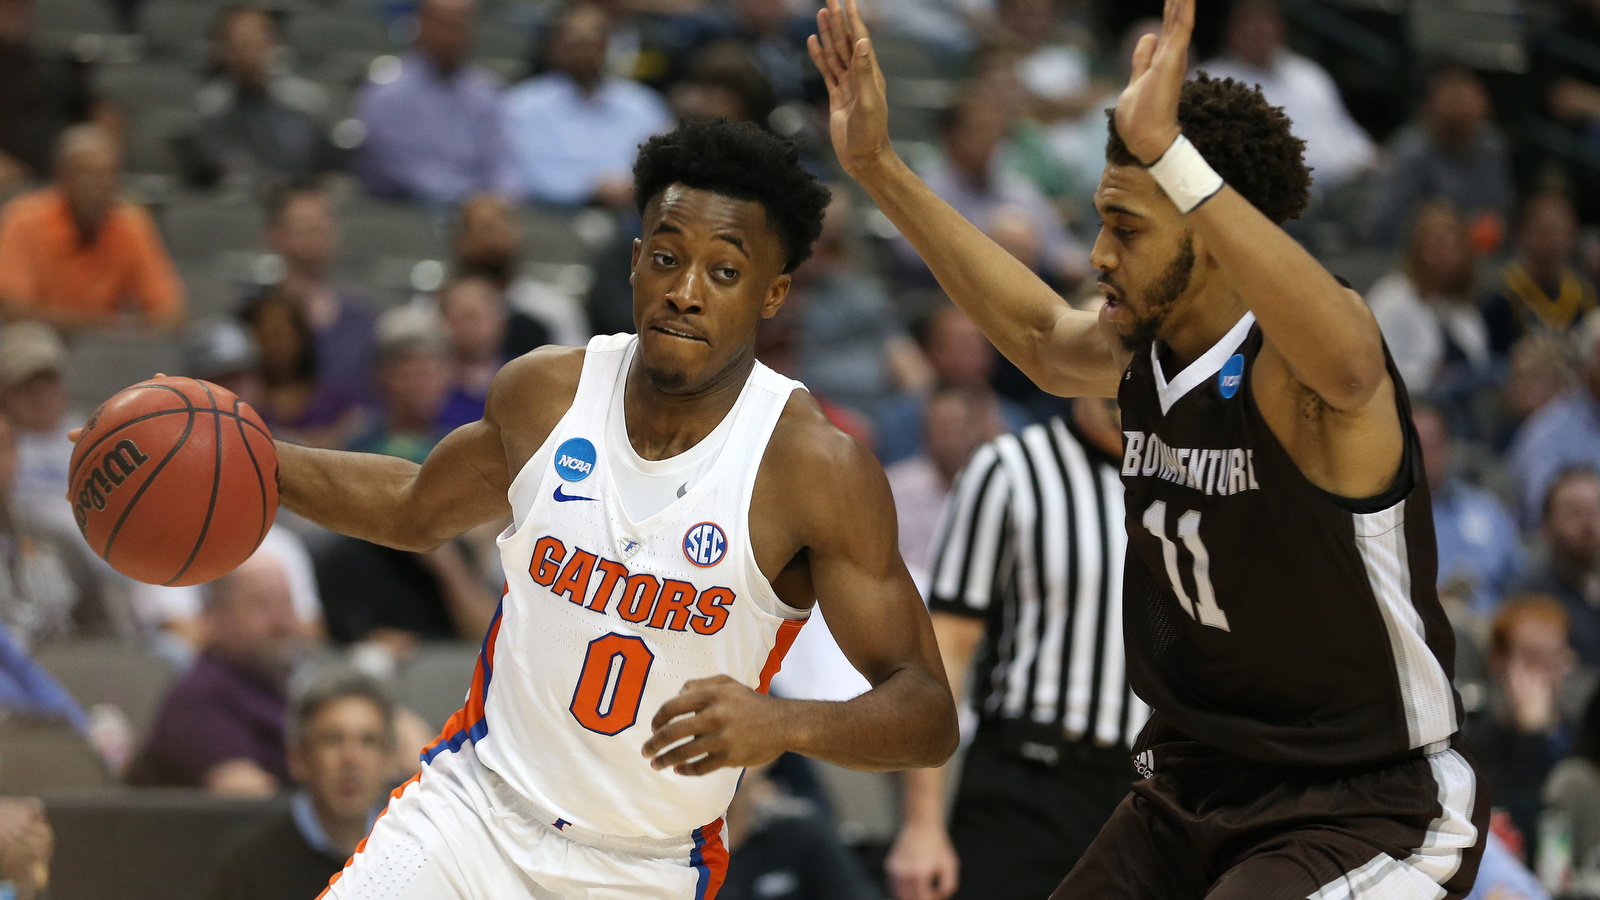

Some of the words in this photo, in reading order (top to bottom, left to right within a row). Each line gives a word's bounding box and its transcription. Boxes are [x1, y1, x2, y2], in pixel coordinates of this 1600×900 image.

[75, 438, 150, 540] Wilso
[557, 454, 592, 474] NCAA
[528, 535, 737, 636] GATORS
[686, 524, 724, 564] SEC
[1142, 500, 1231, 632] 11
[569, 631, 655, 737] 0
